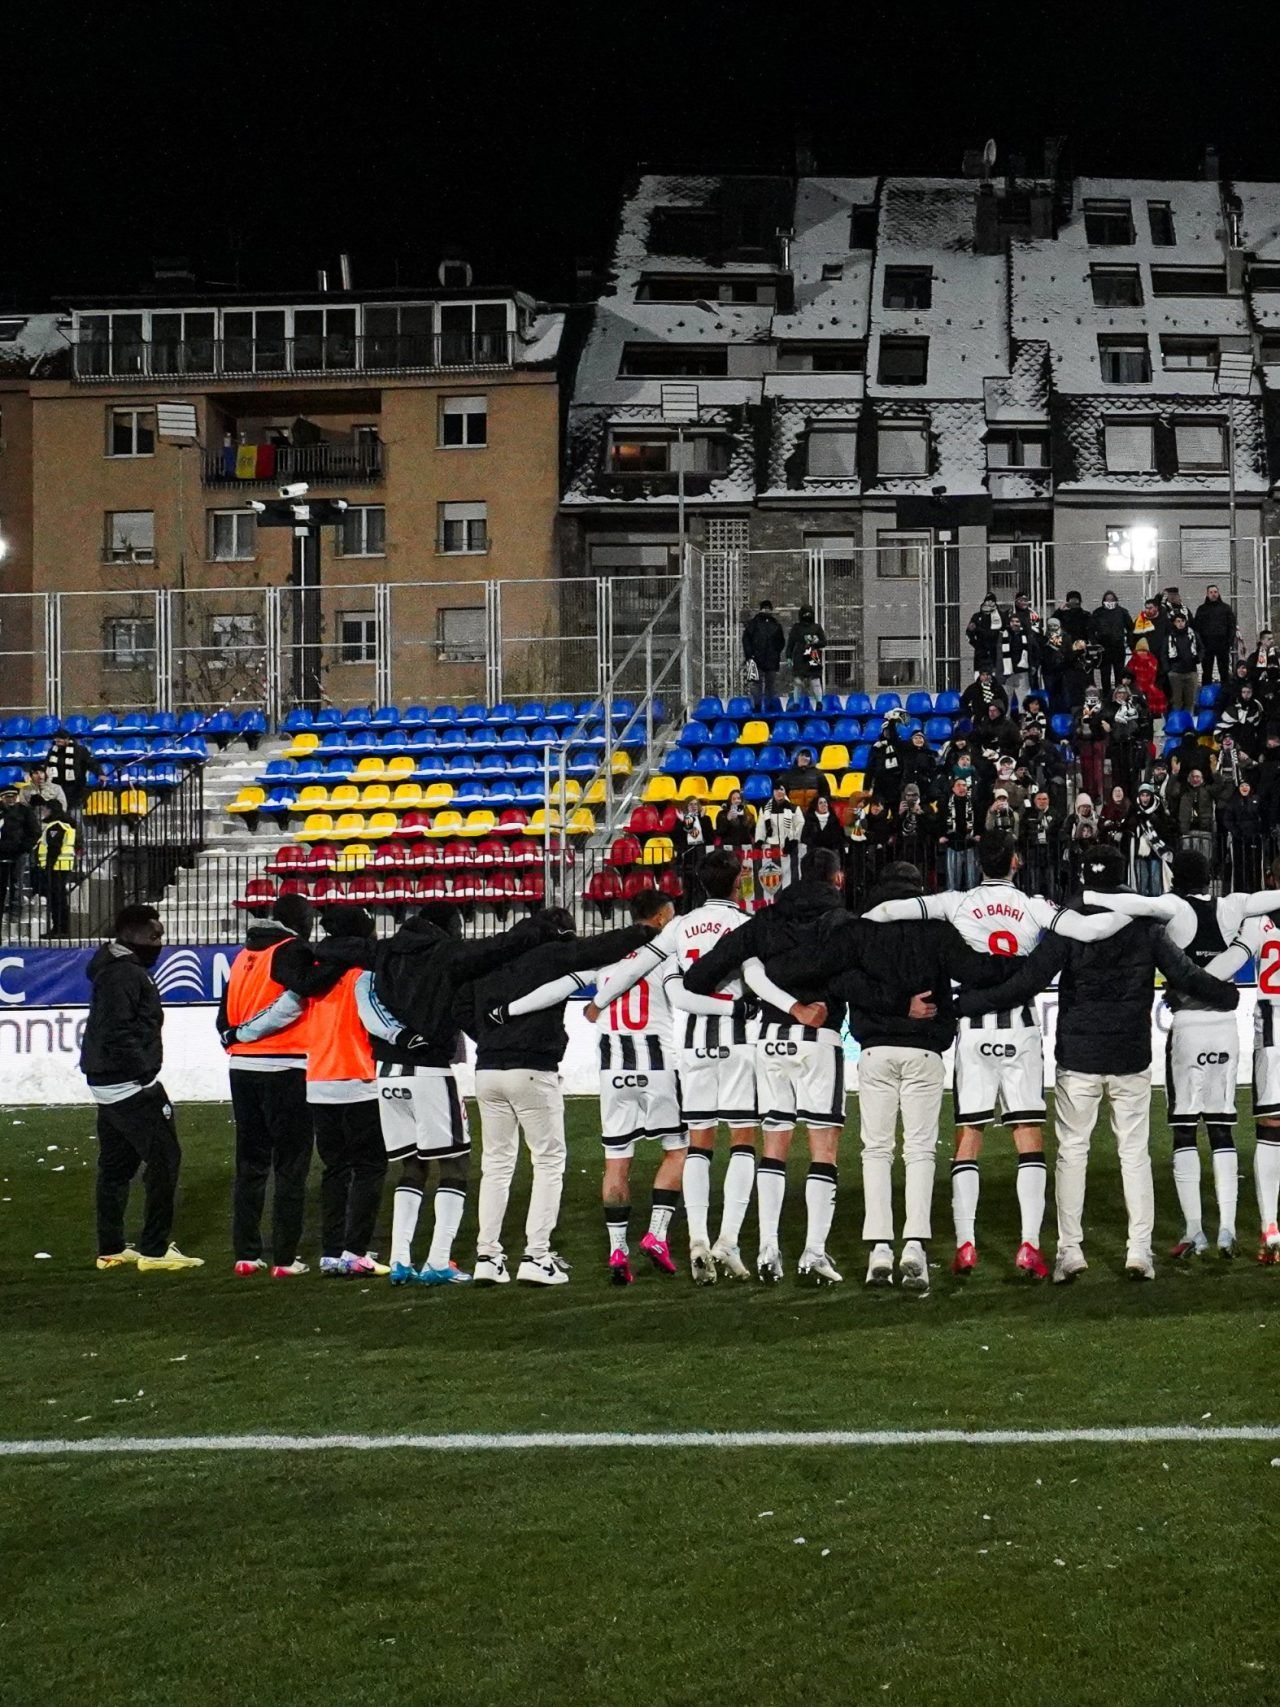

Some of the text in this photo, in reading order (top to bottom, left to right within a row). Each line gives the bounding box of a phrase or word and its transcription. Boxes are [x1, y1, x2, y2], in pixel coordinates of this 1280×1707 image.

[685, 922, 721, 939] LUCAS
[609, 977, 649, 1031] 10
[695, 1046, 731, 1059] CCD
[764, 1042, 798, 1057] CCD
[980, 1043, 1017, 1057] CCD
[1197, 1053, 1230, 1066] CCD
[612, 1075, 649, 1089] CCD
[382, 1087, 412, 1100] CCD
